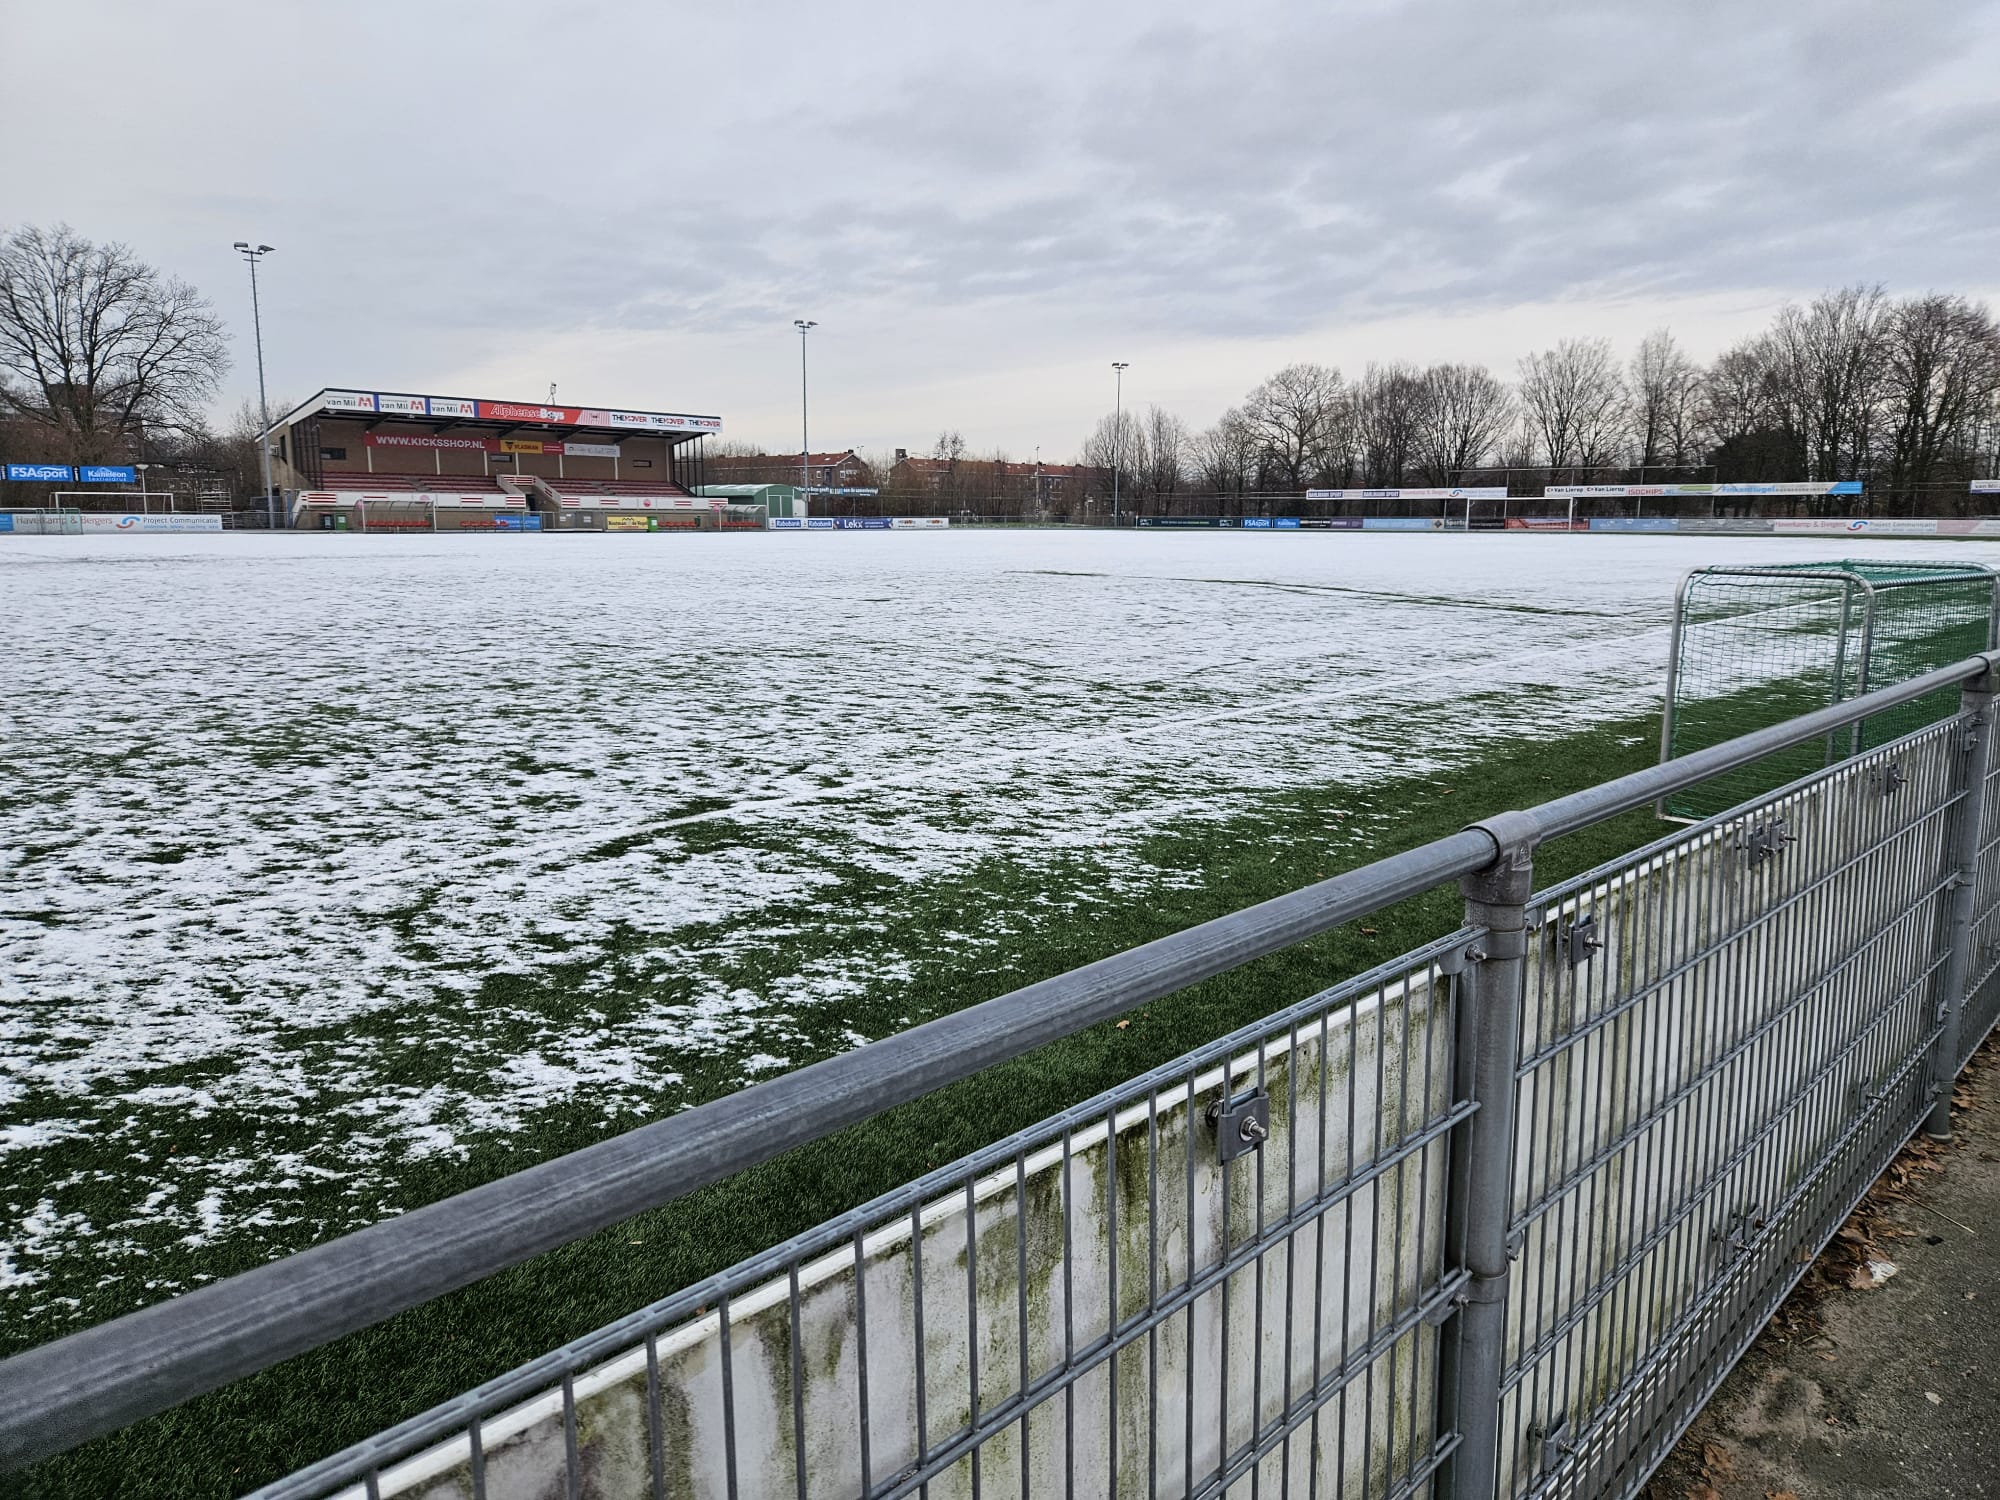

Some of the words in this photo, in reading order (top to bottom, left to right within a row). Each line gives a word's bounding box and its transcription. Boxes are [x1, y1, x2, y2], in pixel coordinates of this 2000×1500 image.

[343, 399, 356, 407] Mil
[396, 402, 408, 410] Mil
[376, 436, 485, 449] WWW.KICKSSHOP.NL
[11, 466, 69, 481] FSAsport
[80, 516, 113, 526] Bergers
[144, 517, 167, 525] Project
